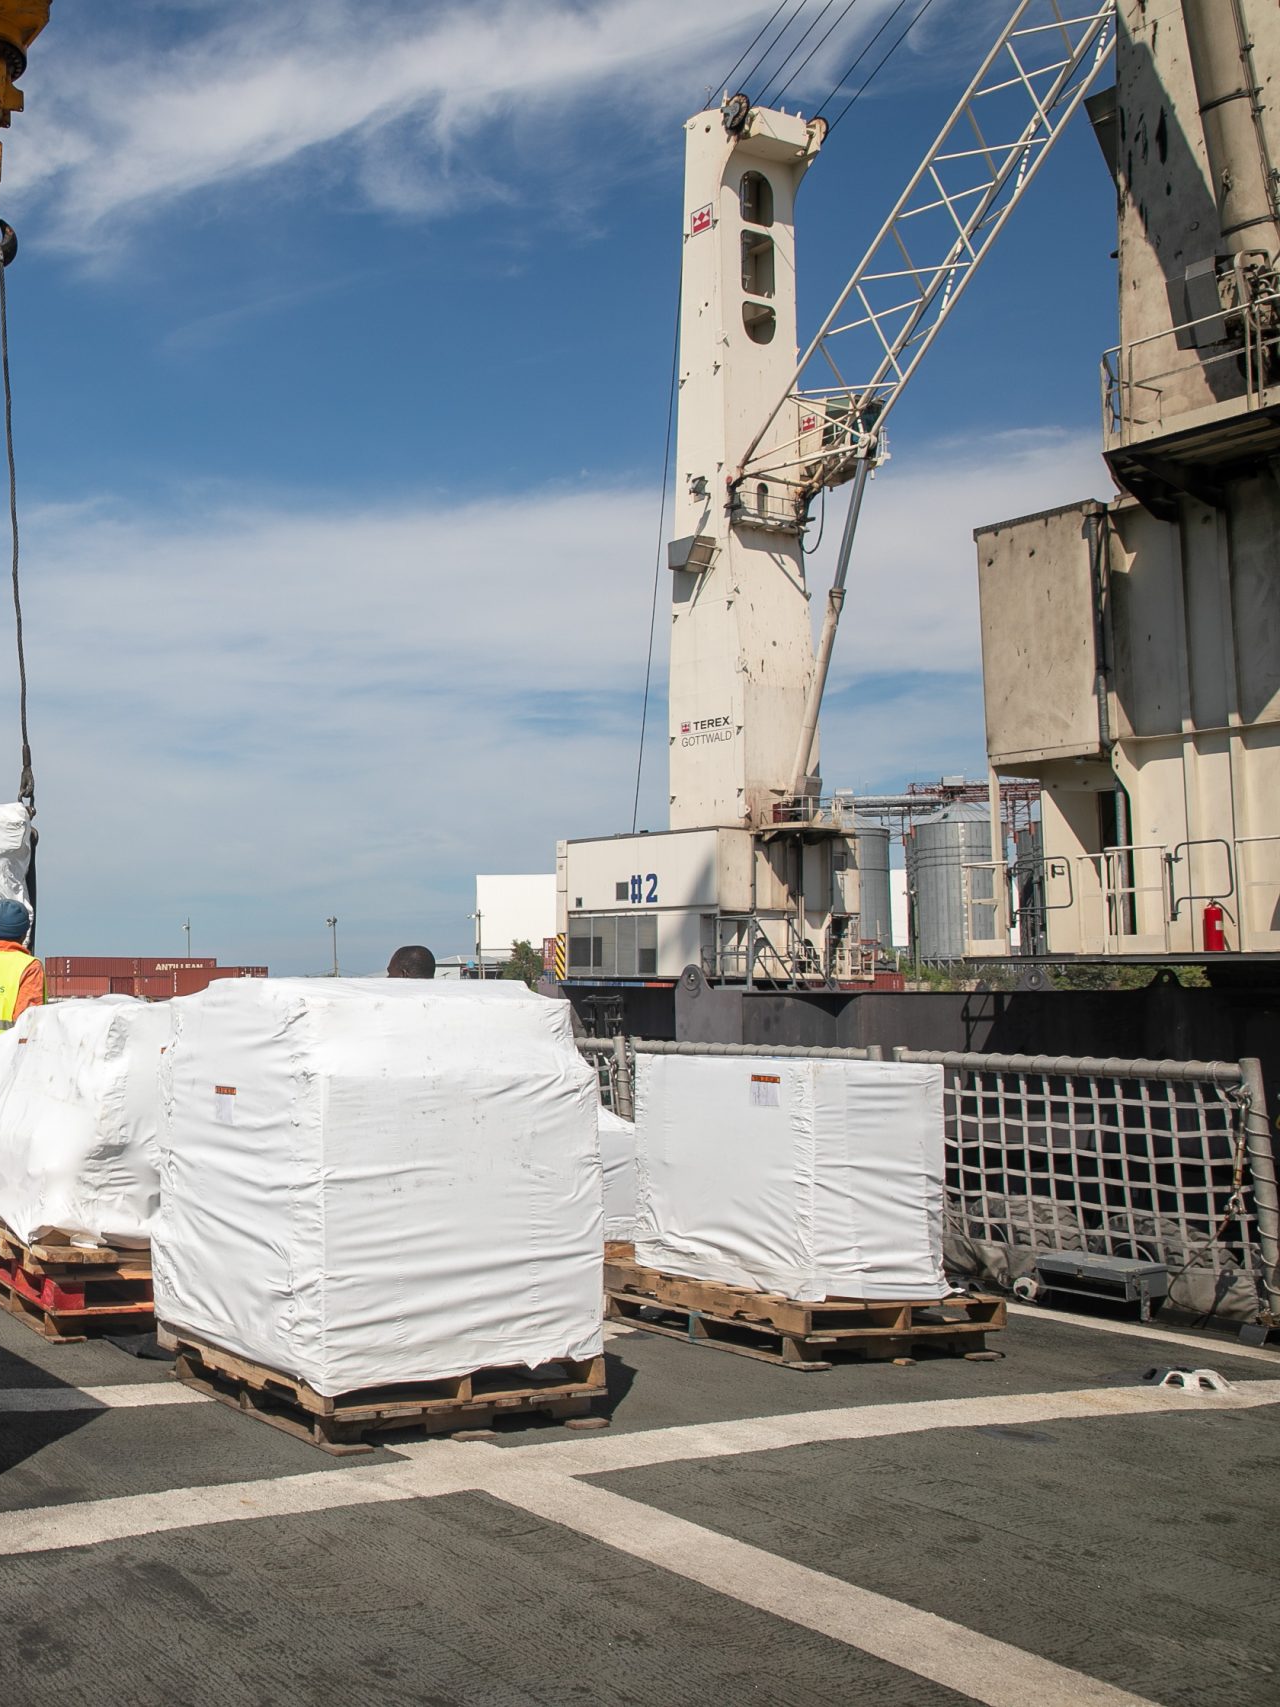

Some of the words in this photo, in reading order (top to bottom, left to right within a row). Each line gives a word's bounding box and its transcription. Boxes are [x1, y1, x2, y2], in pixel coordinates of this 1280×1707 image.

[693, 716, 730, 731] TEREX
[681, 730, 732, 748] GOTTWALD
[630, 873, 658, 904] #2
